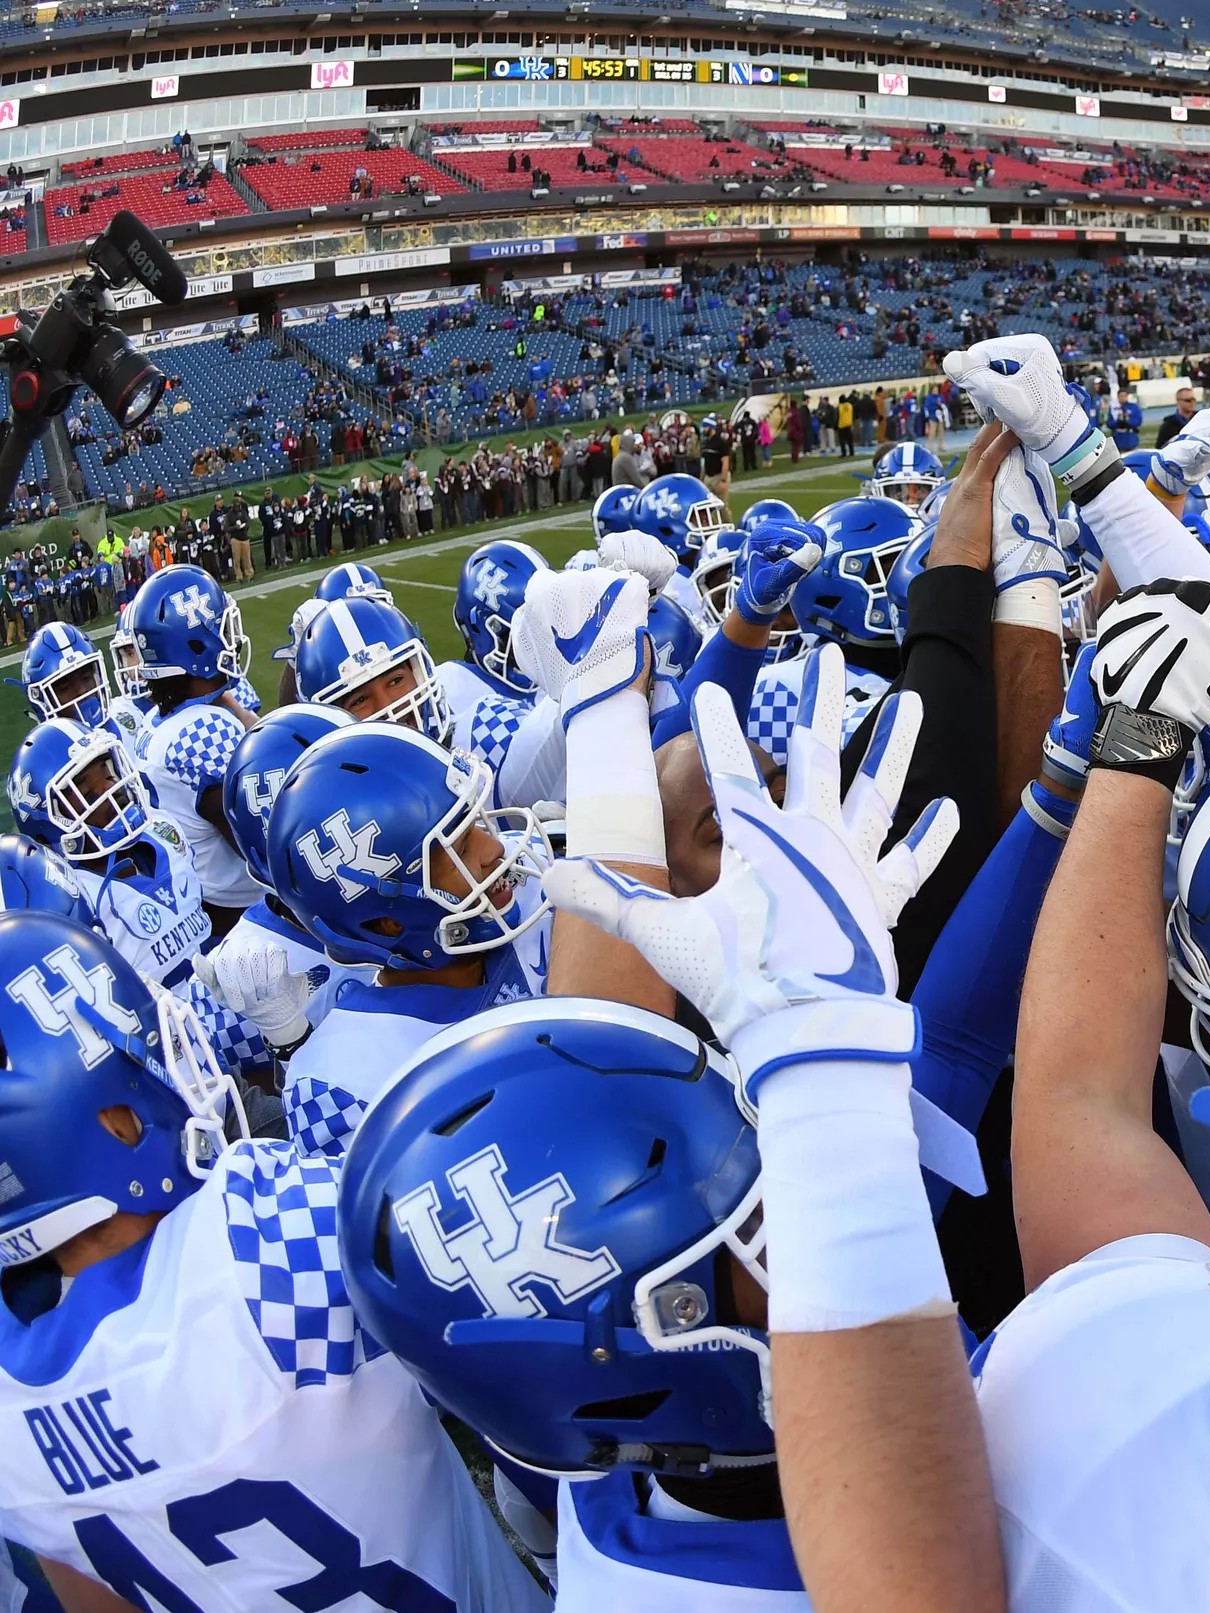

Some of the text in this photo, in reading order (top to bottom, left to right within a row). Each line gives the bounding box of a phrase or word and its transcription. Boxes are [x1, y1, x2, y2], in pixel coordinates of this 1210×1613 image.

[317, 60, 348, 90] lyft
[495, 61, 510, 77] 0
[558, 66, 567, 77] 3
[583, 60, 624, 77] 45:53
[712, 70, 721, 81] 3
[760, 68, 773, 83] 0
[155, 79, 175, 94] lyft
[883, 73, 904, 95] lyft
[491, 244, 540, 257] UNITED
[603, 235, 638, 248] FedEx
[127, 239, 163, 287] RØDE
[121, 295, 137, 308] Lite
[190, 284, 206, 296] Lite
[212, 279, 229, 292] Lite
[1025, 549, 1042, 569] XXL
[296, 808, 403, 903] UK
[138, 902, 162, 934] SEC
[5, 943, 143, 1071] UK
[391, 1142, 622, 1320] UK
[24, 1388, 161, 1497] BLUE
